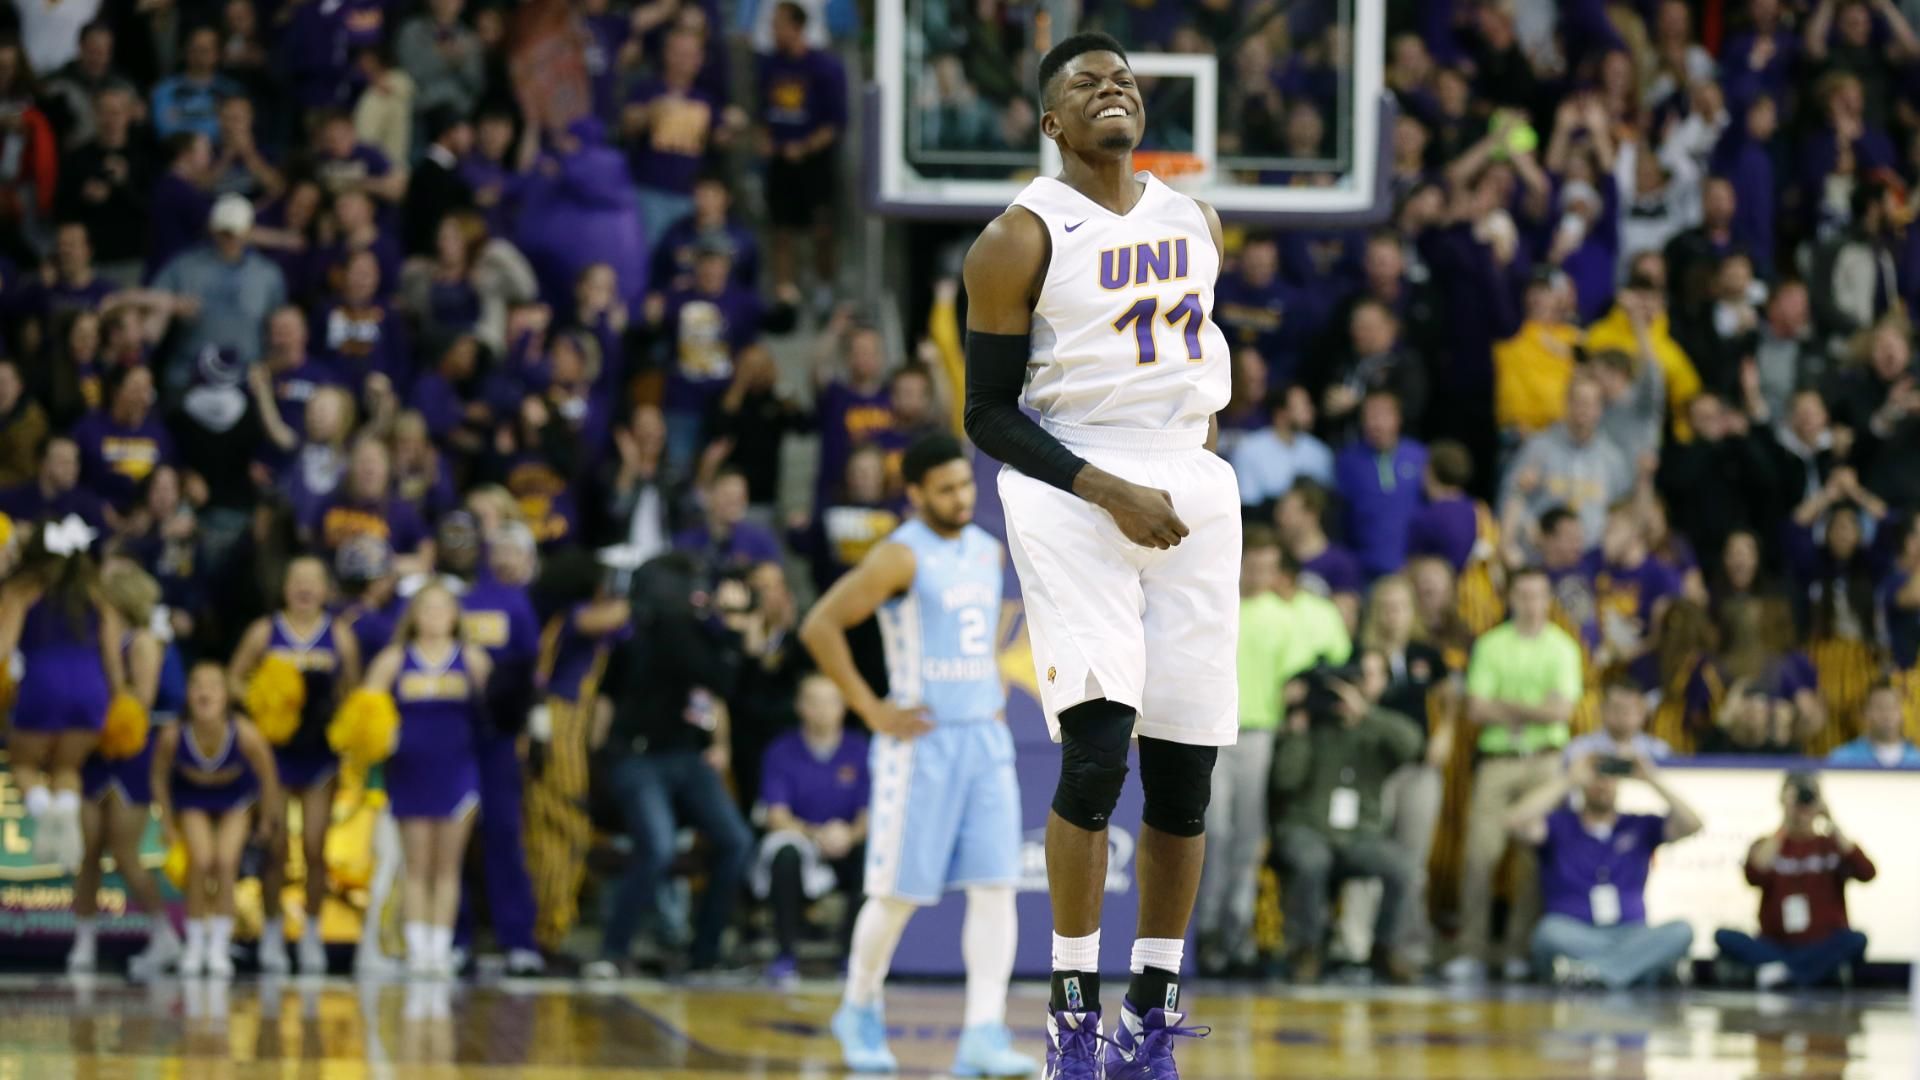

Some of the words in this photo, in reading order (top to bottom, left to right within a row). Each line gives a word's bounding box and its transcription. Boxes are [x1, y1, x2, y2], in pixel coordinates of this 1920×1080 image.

[1098, 236, 1189, 291] UNI
[1111, 289, 1204, 366] 11
[959, 606, 989, 655] 2
